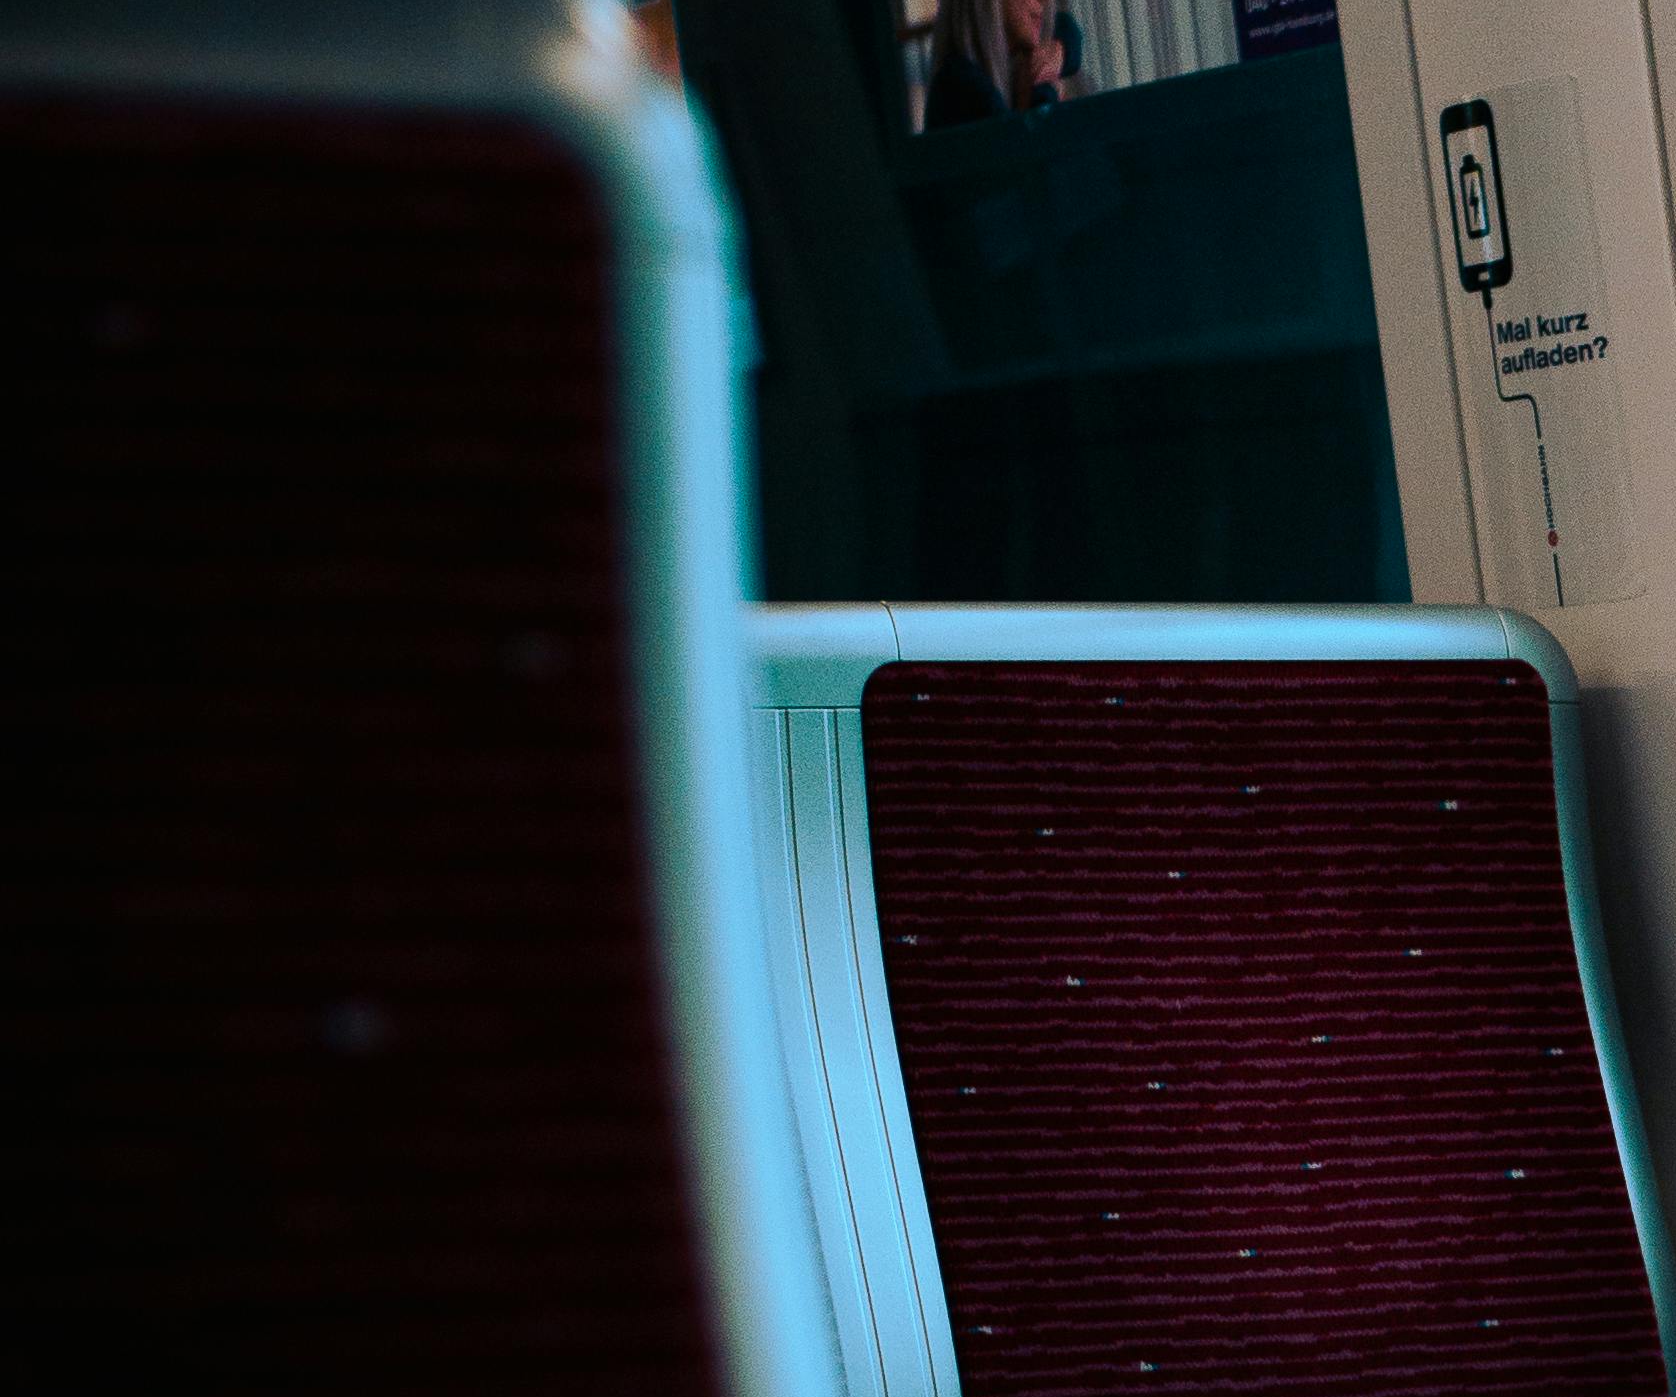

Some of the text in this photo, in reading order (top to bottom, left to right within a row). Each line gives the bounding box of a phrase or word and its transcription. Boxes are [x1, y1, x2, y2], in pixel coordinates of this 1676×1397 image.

[1496, 313, 1589, 344] Mal kurz
[1501, 335, 1608, 375] aufladen?
